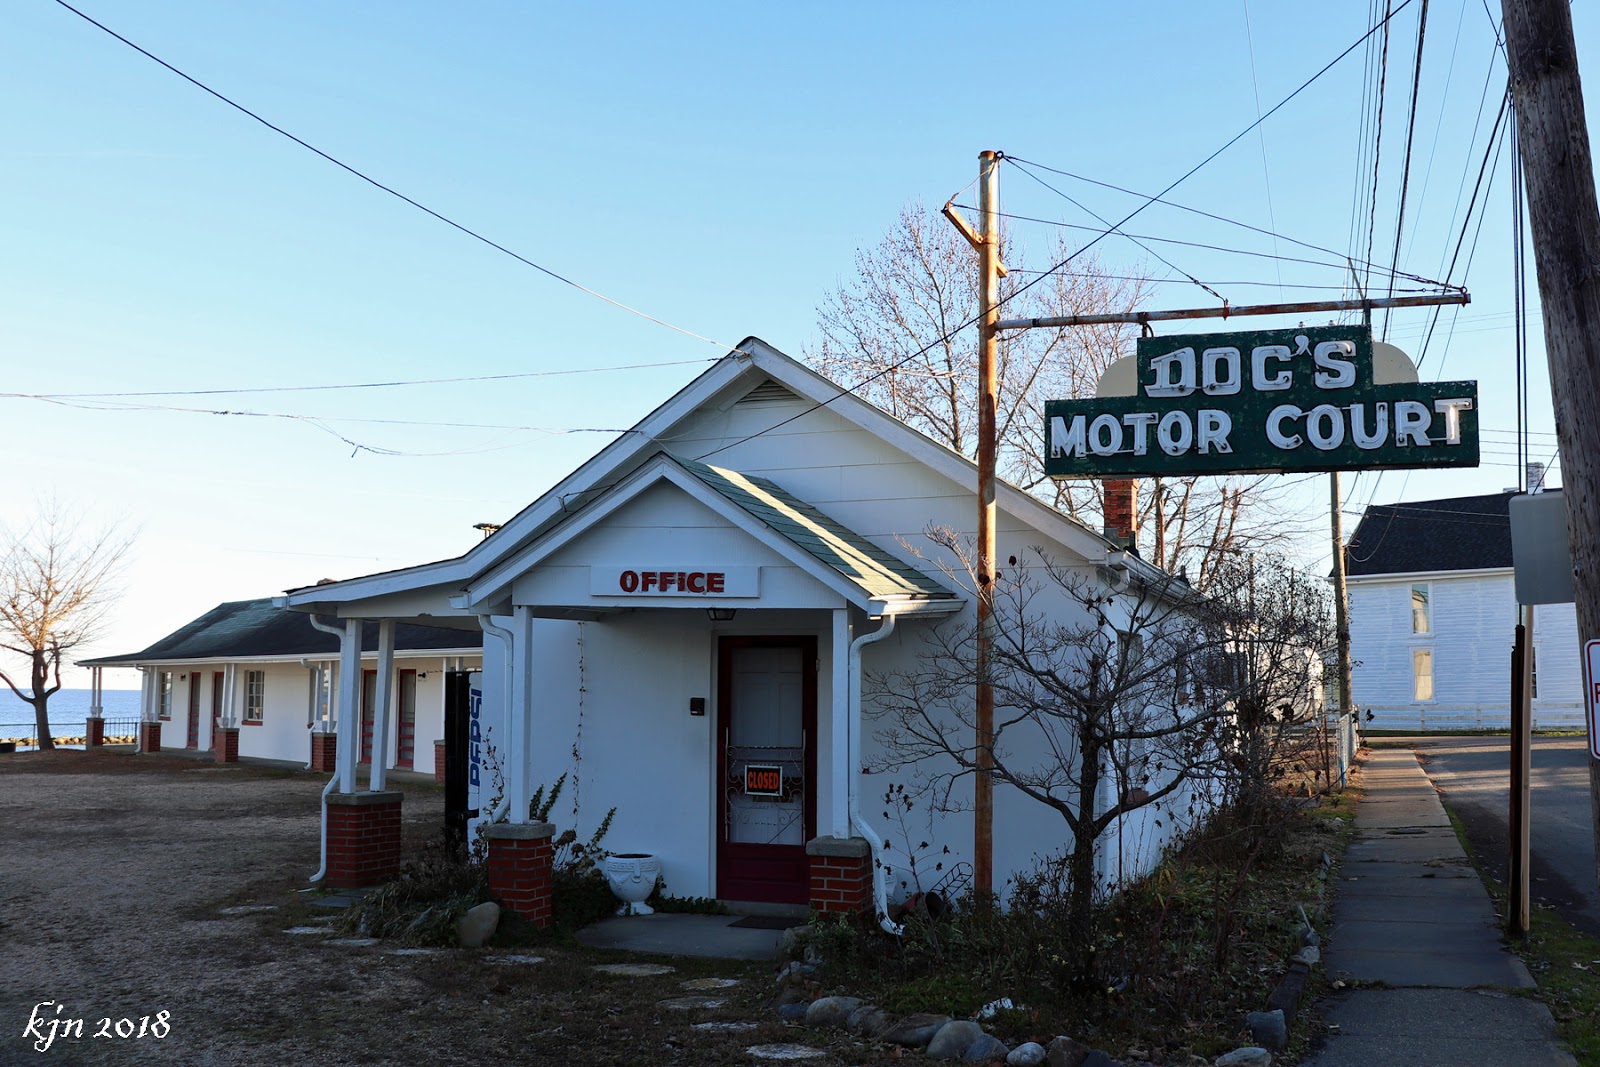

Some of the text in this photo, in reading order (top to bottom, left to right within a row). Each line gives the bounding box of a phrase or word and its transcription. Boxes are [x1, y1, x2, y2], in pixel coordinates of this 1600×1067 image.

[1143, 334, 1357, 398] DOC'S
[1050, 398, 1473, 459] MOTOR COURT
[619, 570, 725, 593] OFFICE
[747, 770, 779, 790] CLOSED
